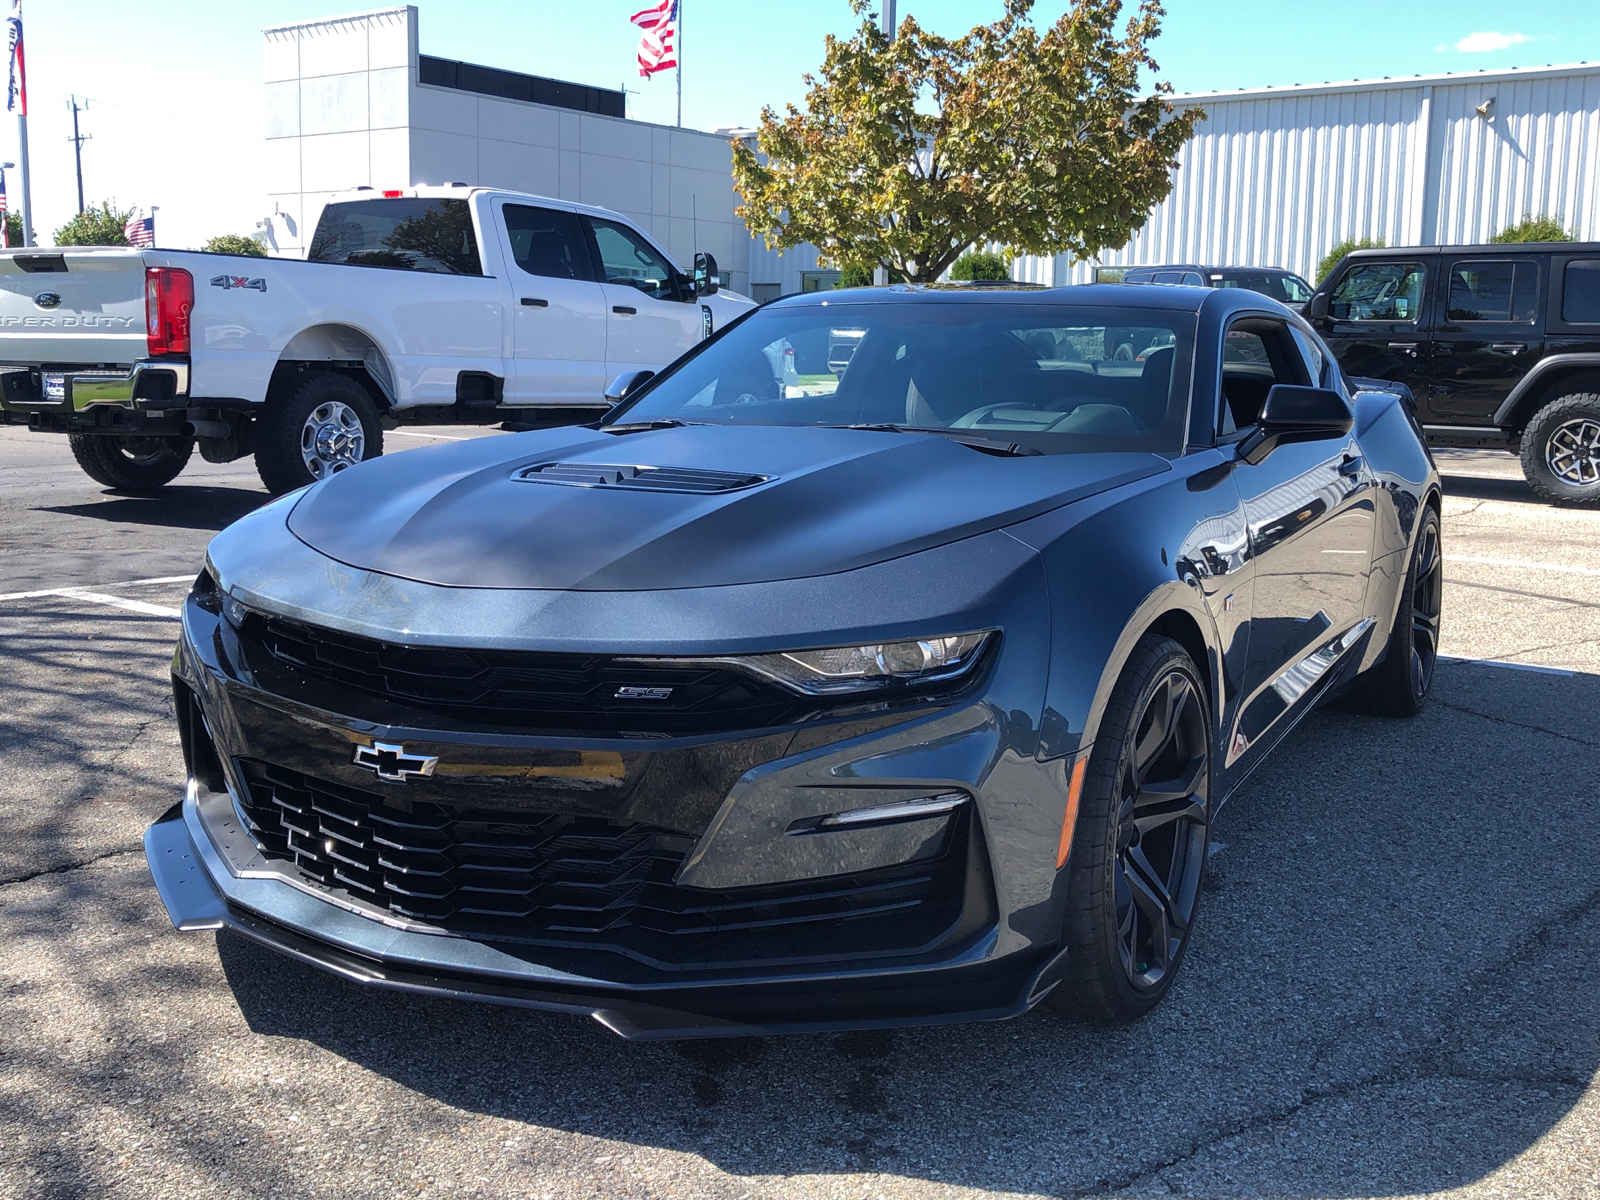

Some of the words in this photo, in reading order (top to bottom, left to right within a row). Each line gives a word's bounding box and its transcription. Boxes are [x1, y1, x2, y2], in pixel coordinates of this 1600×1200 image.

[0, 316, 56, 327] PER
[62, 316, 135, 328] DUTY
[614, 686, 673, 699] SS
